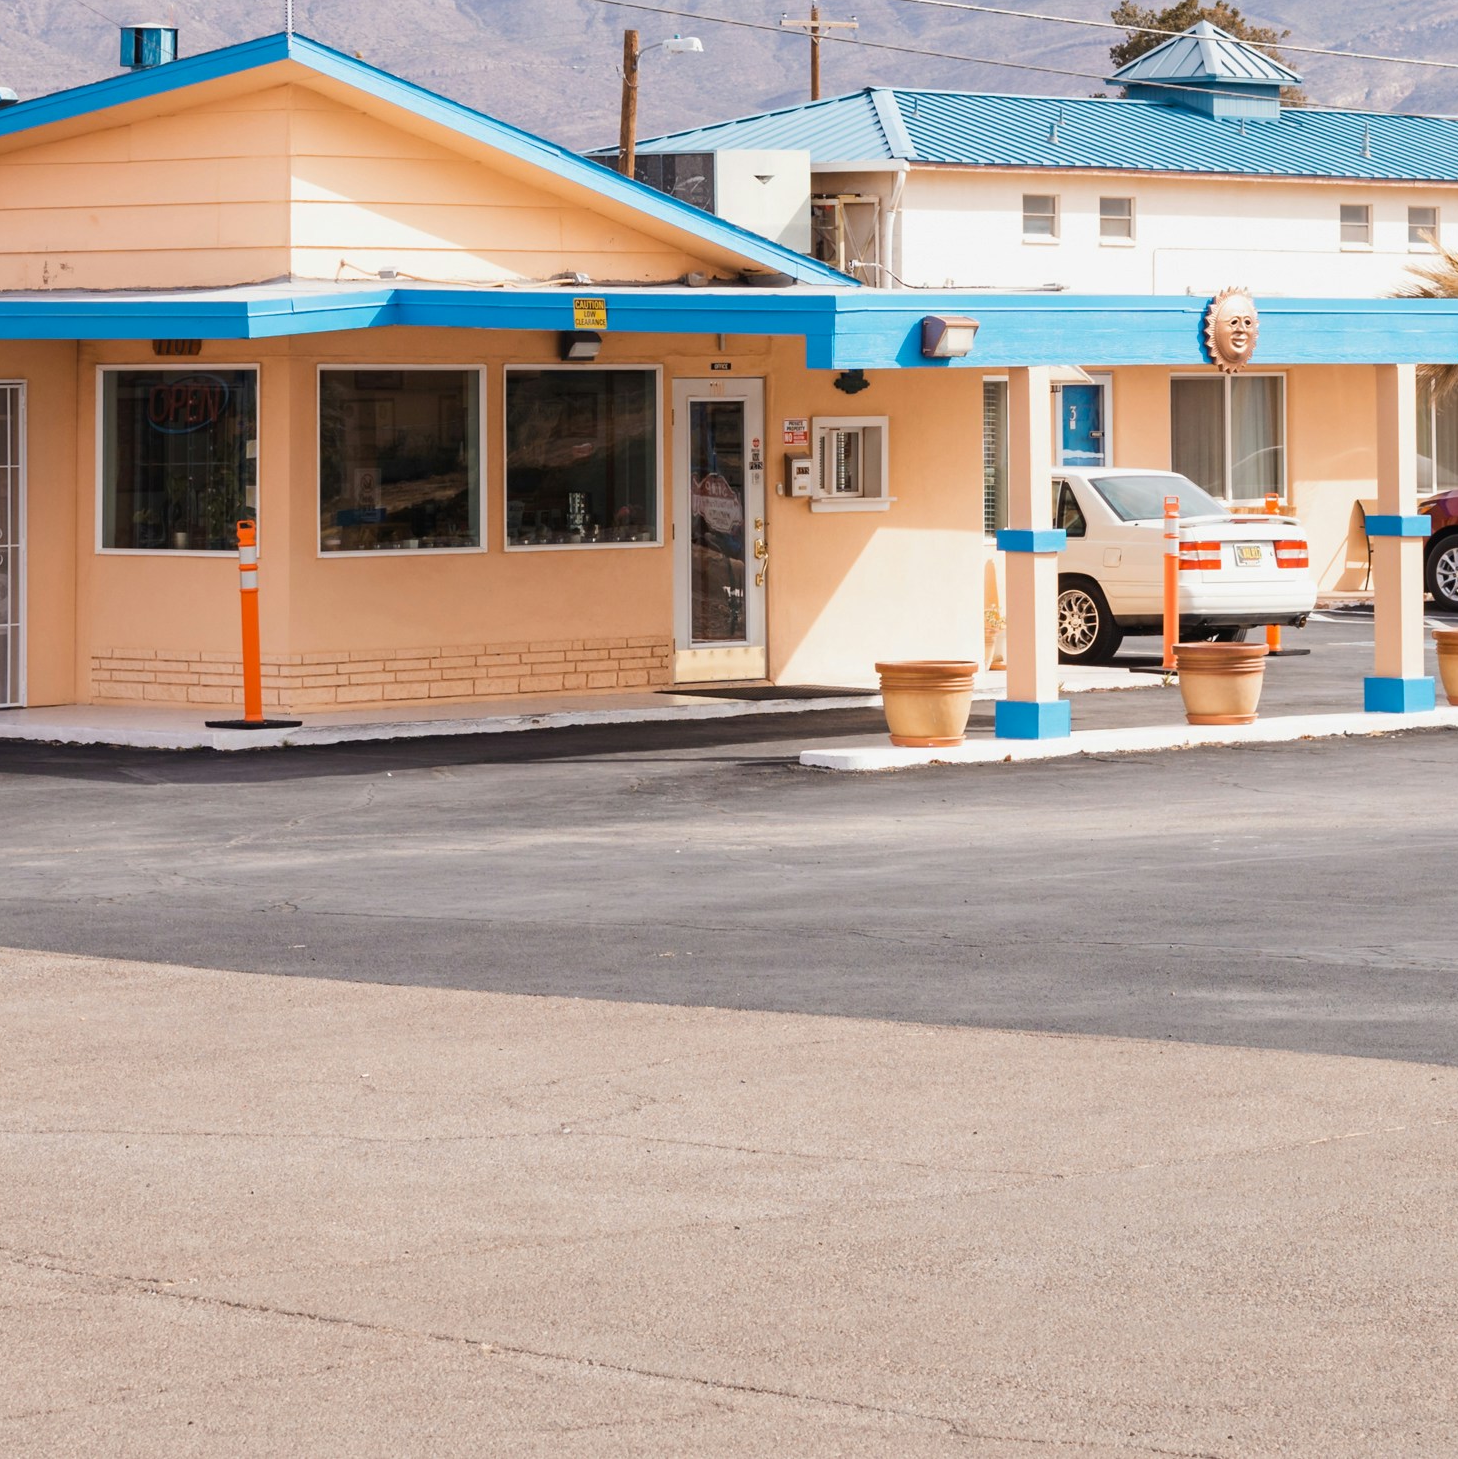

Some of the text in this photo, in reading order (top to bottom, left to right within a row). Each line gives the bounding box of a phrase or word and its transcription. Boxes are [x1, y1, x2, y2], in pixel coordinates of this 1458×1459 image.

[575, 300, 604, 309] CAUTION
[576, 318, 606, 326] CLEARANCE
[149, 383, 221, 423] OPEN
[784, 432, 793, 443] NO
